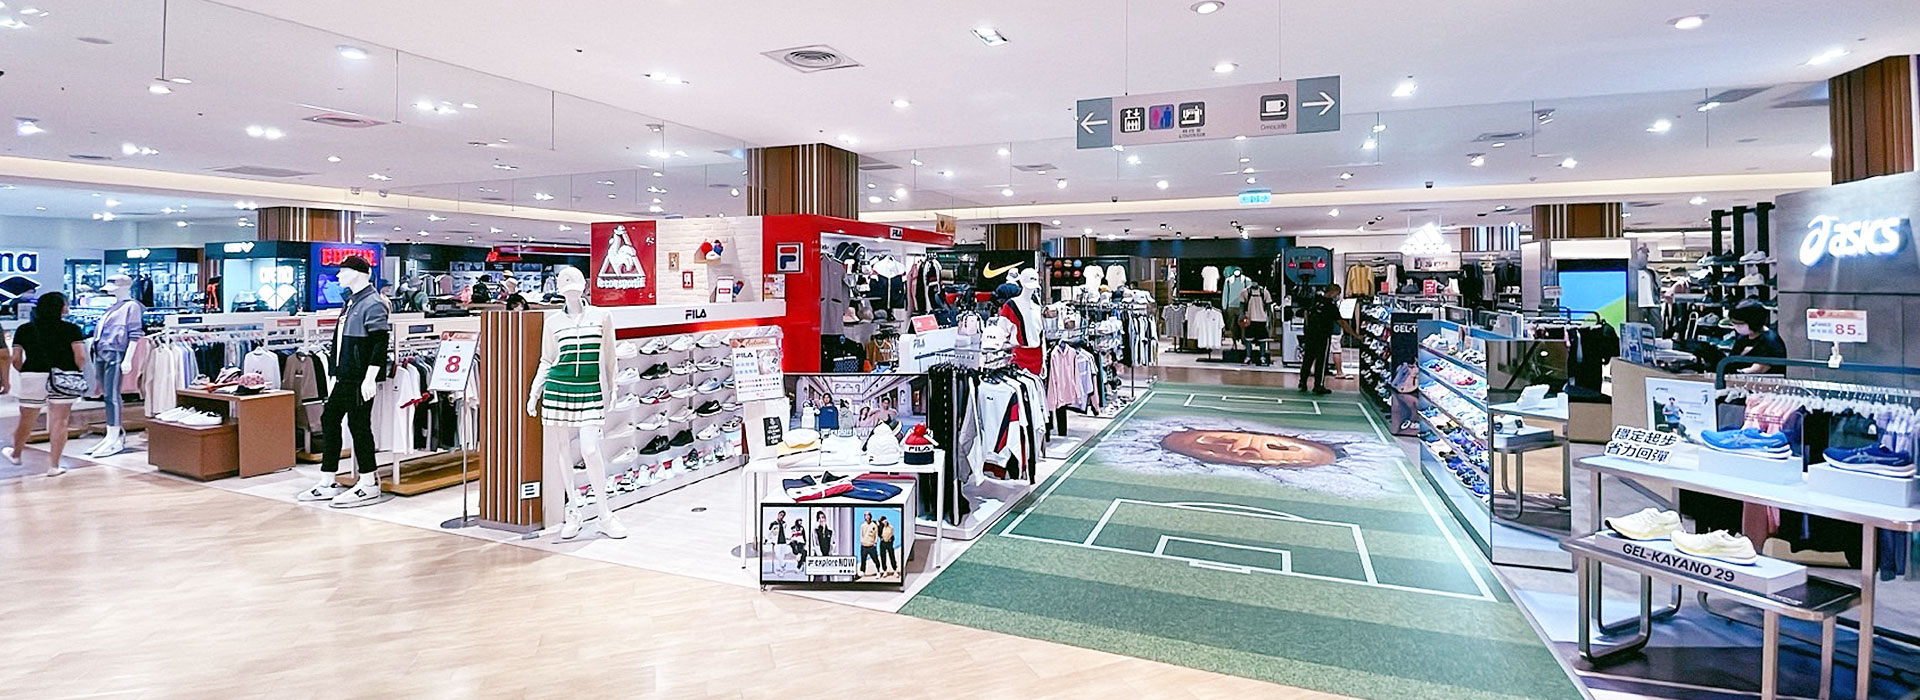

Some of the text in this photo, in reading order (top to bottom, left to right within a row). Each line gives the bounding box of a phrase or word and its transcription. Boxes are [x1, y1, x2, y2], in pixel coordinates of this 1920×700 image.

[1828, 217, 1901, 257] asics
[685, 308, 707, 320] FILA
[1835, 324, 1856, 335] 85
[445, 355, 461, 373] 8
[1614, 427, 1677, 447] 穩定起步
[1606, 442, 1670, 462] 省力回彈
[814, 558, 855, 567] explore NOW
[1622, 543, 1735, 582] GEL-KAYANO 29
